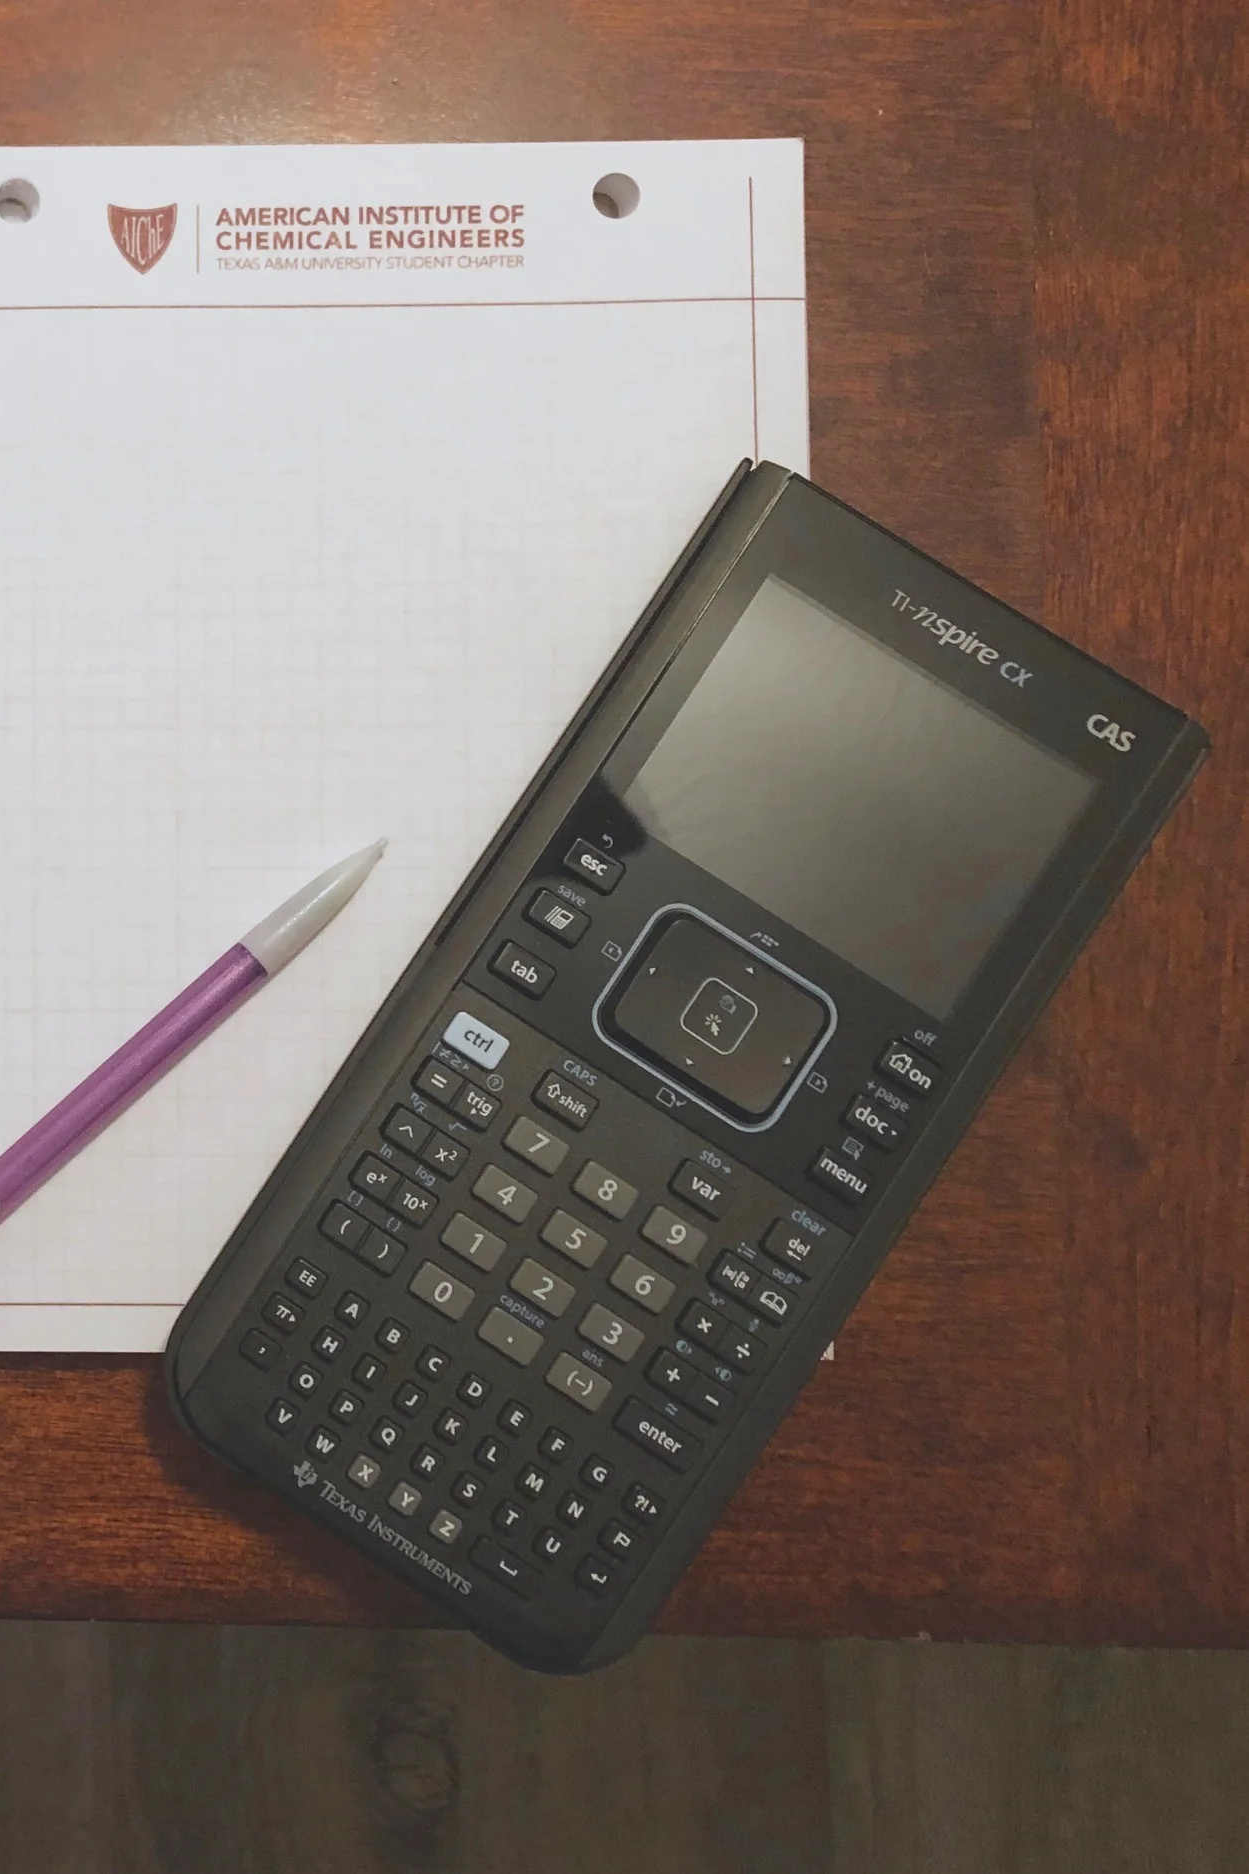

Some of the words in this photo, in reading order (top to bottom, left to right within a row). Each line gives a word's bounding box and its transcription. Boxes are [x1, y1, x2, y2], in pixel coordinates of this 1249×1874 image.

[215, 206, 350, 227] AMERICAN
[358, 205, 482, 226] INSTITUTE
[489, 204, 525, 225] OF
[216, 231, 357, 250] CHEMICAL
[368, 228, 525, 250] ENGINEERS
[216, 257, 260, 271] TEXAS
[264, 256, 299, 271] A&M
[301, 256, 382, 271] UNIVERSITY
[386, 255, 454, 270] STUDENT
[457, 255, 525, 269] CHAPTER
[999, 660, 1035, 688] CX
[1085, 713, 1137, 753] CAS
[580, 853, 608, 876] esc
[556, 884, 587, 907] save
[510, 959, 538, 984] tab
[463, 1028, 495, 1053] ctrl
[913, 1029, 938, 1047] off
[563, 1059, 598, 1087] CAPS
[908, 1068, 933, 1090] on
[466, 1091, 494, 1117] trig
[558, 1095, 589, 1118] shift
[854, 1106, 889, 1135] doc
[527, 1132, 551, 1153] 7
[699, 1149, 722, 1168] sto
[414, 1165, 437, 1187] log
[819, 1156, 868, 1194] menu
[497, 1185, 517, 1205] 4
[597, 1179, 618, 1201] 8
[691, 1176, 721, 1201] var
[790, 1209, 827, 1237] clear
[469, 1233, 484, 1254] 1
[564, 1228, 587, 1250] 5
[665, 1224, 687, 1245] 9
[788, 1237, 811, 1257] del
[298, 1269, 317, 1288] EE
[532, 1276, 554, 1301] 2
[634, 1275, 656, 1296] 6
[433, 1281, 453, 1303] 0
[344, 1303, 359, 1319] A
[499, 1294, 546, 1329] capture
[386, 1328, 401, 1344] B
[601, 1321, 624, 1345] 3
[321, 1336, 339, 1353] H
[428, 1357, 443, 1372] C
[581, 1348, 605, 1368] ans
[366, 1365, 376, 1380] I
[467, 1381, 483, 1398] D
[339, 1400, 354, 1414] P
[404, 1394, 419, 1407] J
[277, 1407, 293, 1424] V
[509, 1410, 525, 1427] E
[381, 1427, 396, 1446] Q
[444, 1417, 461, 1436] K
[638, 1420, 683, 1453] enter
[315, 1434, 335, 1454] W
[486, 1445, 497, 1463] L
[550, 1437, 566, 1452] F
[357, 1464, 374, 1482] X
[420, 1454, 436, 1472] R
[524, 1472, 545, 1493] M
[592, 1466, 608, 1483] G
[401, 1491, 415, 1508] Y
[462, 1483, 477, 1498] S
[505, 1509, 519, 1526] T
[567, 1500, 585, 1519] N
[319, 1480, 368, 1523] TEXAS
[366, 1514, 473, 1596] INSTRUMENTS
[439, 1520, 455, 1537] Z
[545, 1536, 562, 1554] U
